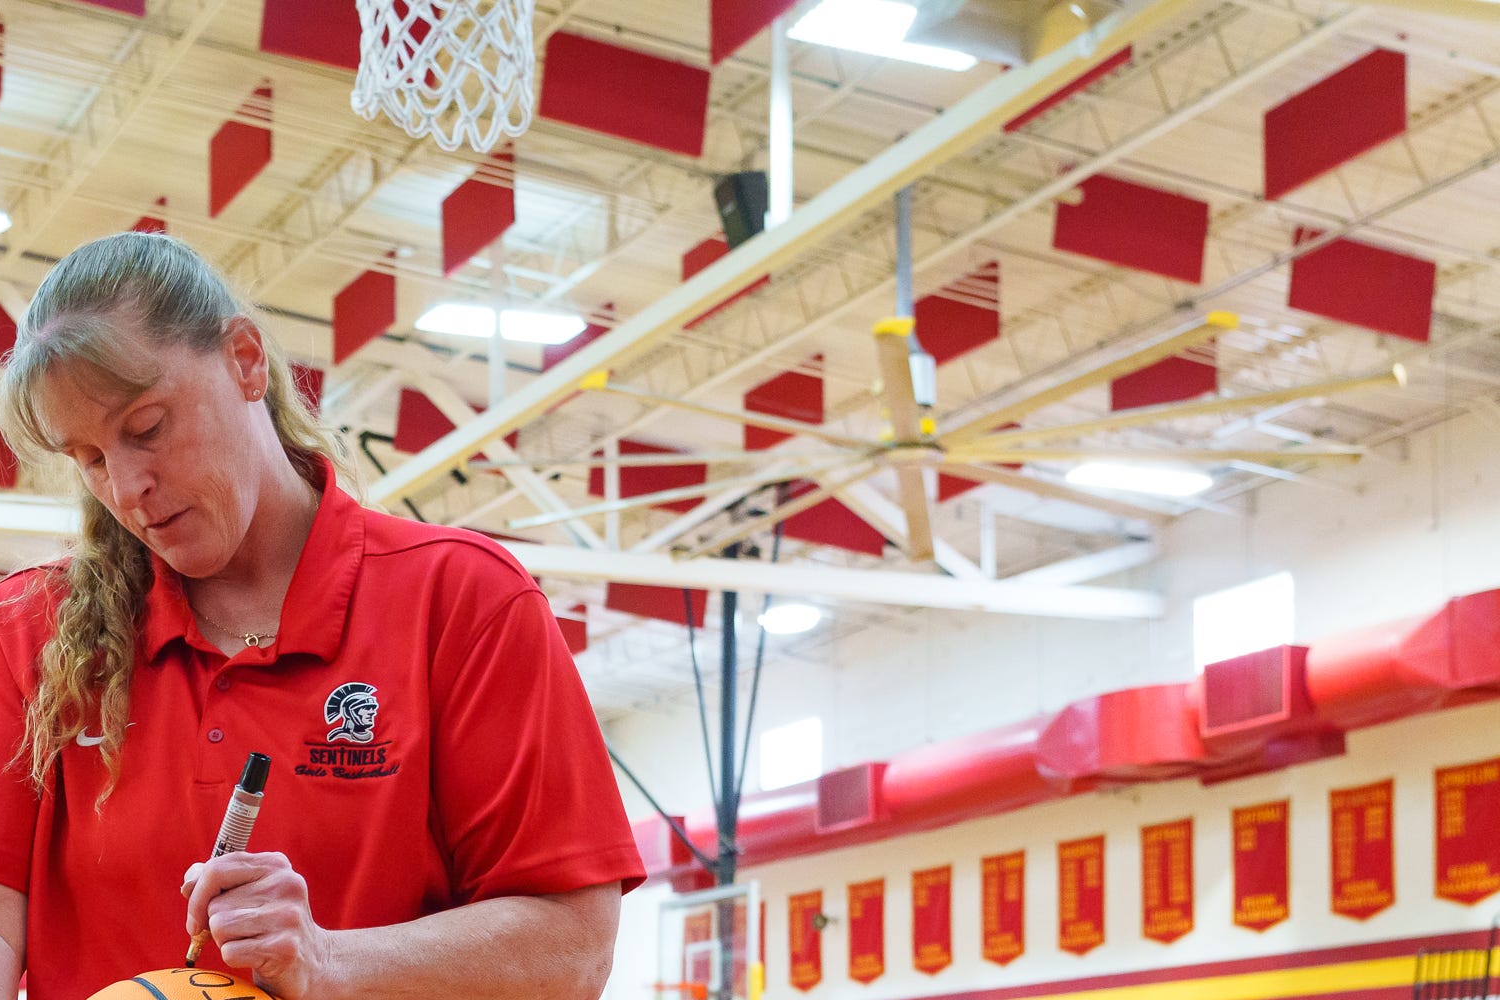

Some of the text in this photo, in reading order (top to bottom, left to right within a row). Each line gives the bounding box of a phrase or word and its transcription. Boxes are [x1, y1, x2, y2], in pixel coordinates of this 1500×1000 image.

[309, 747, 387, 766] SENTINELS
[294, 763, 400, 780] Girls Basketball
